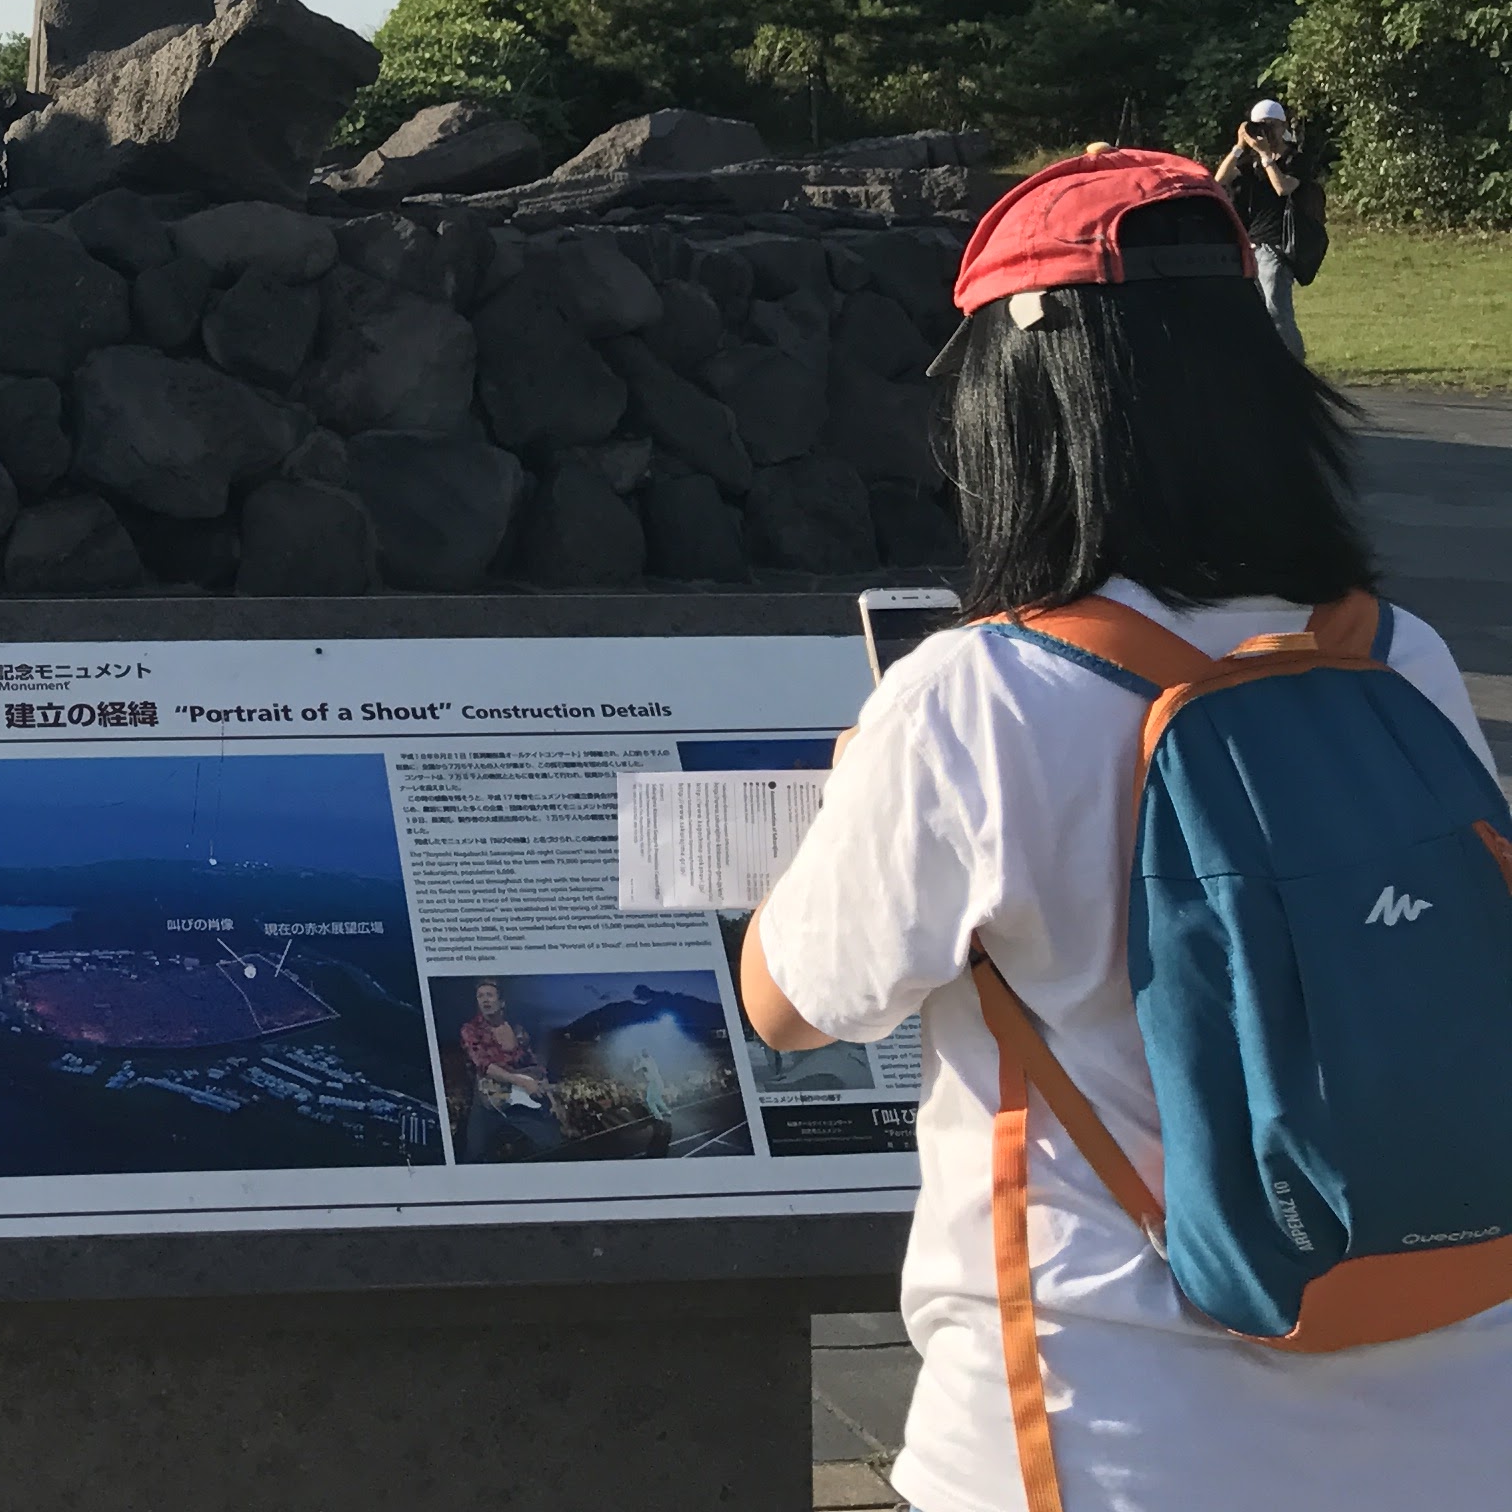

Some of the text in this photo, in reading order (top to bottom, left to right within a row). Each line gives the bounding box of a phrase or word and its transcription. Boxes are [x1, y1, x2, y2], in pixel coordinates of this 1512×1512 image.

[300, 702, 329, 721] of
[337, 706, 353, 721] a
[461, 703, 595, 719] Construction
[600, 702, 672, 718] Details
[166, 918, 234, 932] 叫びの肖像
[264, 921, 384, 936] 現在の赤水展望広場
[1274, 1181, 1314, 1251] ARPENAZ 10
[1402, 1225, 1502, 1245] Quechua
